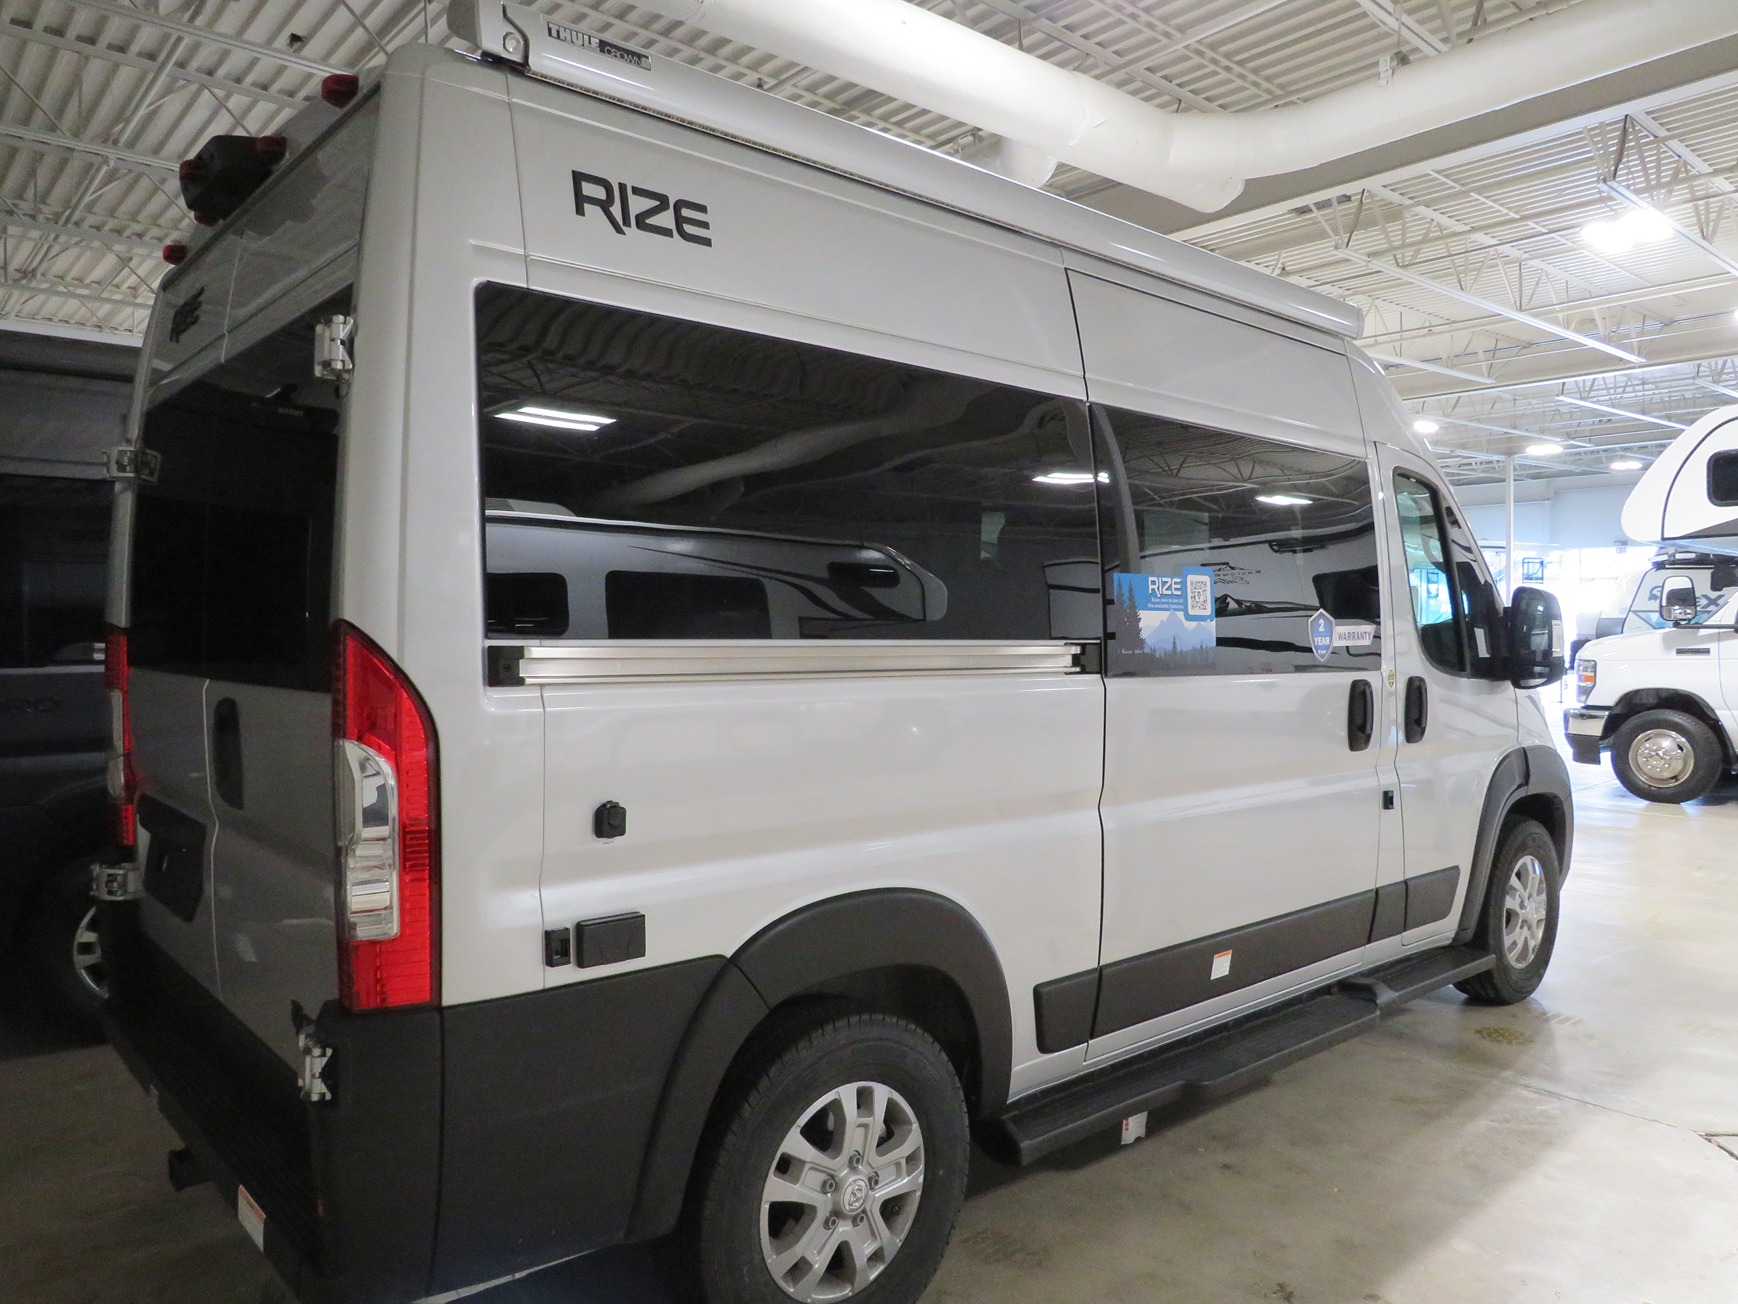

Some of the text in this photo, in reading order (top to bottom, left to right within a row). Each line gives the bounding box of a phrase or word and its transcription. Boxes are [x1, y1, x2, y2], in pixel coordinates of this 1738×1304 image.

[547, 22, 600, 51] THULE
[571, 169, 713, 248] RIZE
[1148, 576, 1182, 598] RIZE
[1318, 619, 1325, 631] 2
[1313, 636, 1330, 645] YEAR
[1337, 631, 1372, 641] WARRANTY
